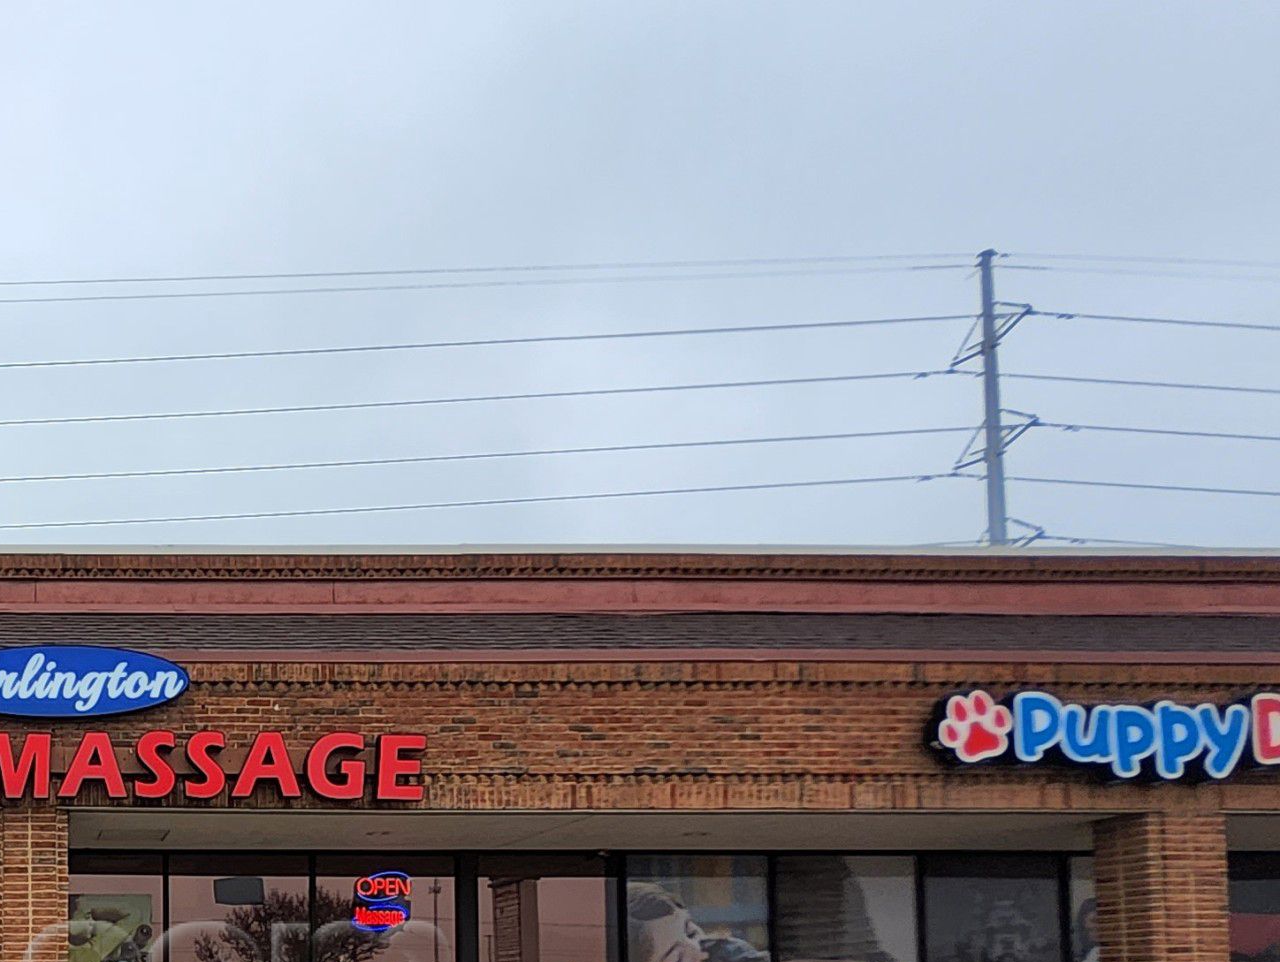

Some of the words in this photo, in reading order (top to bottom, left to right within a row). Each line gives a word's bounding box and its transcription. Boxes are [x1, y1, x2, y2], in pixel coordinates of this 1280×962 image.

[1012, 690, 1250, 780] Puppy
[356, 877, 411, 896] OPEN
[355, 906, 406, 928] Massage
